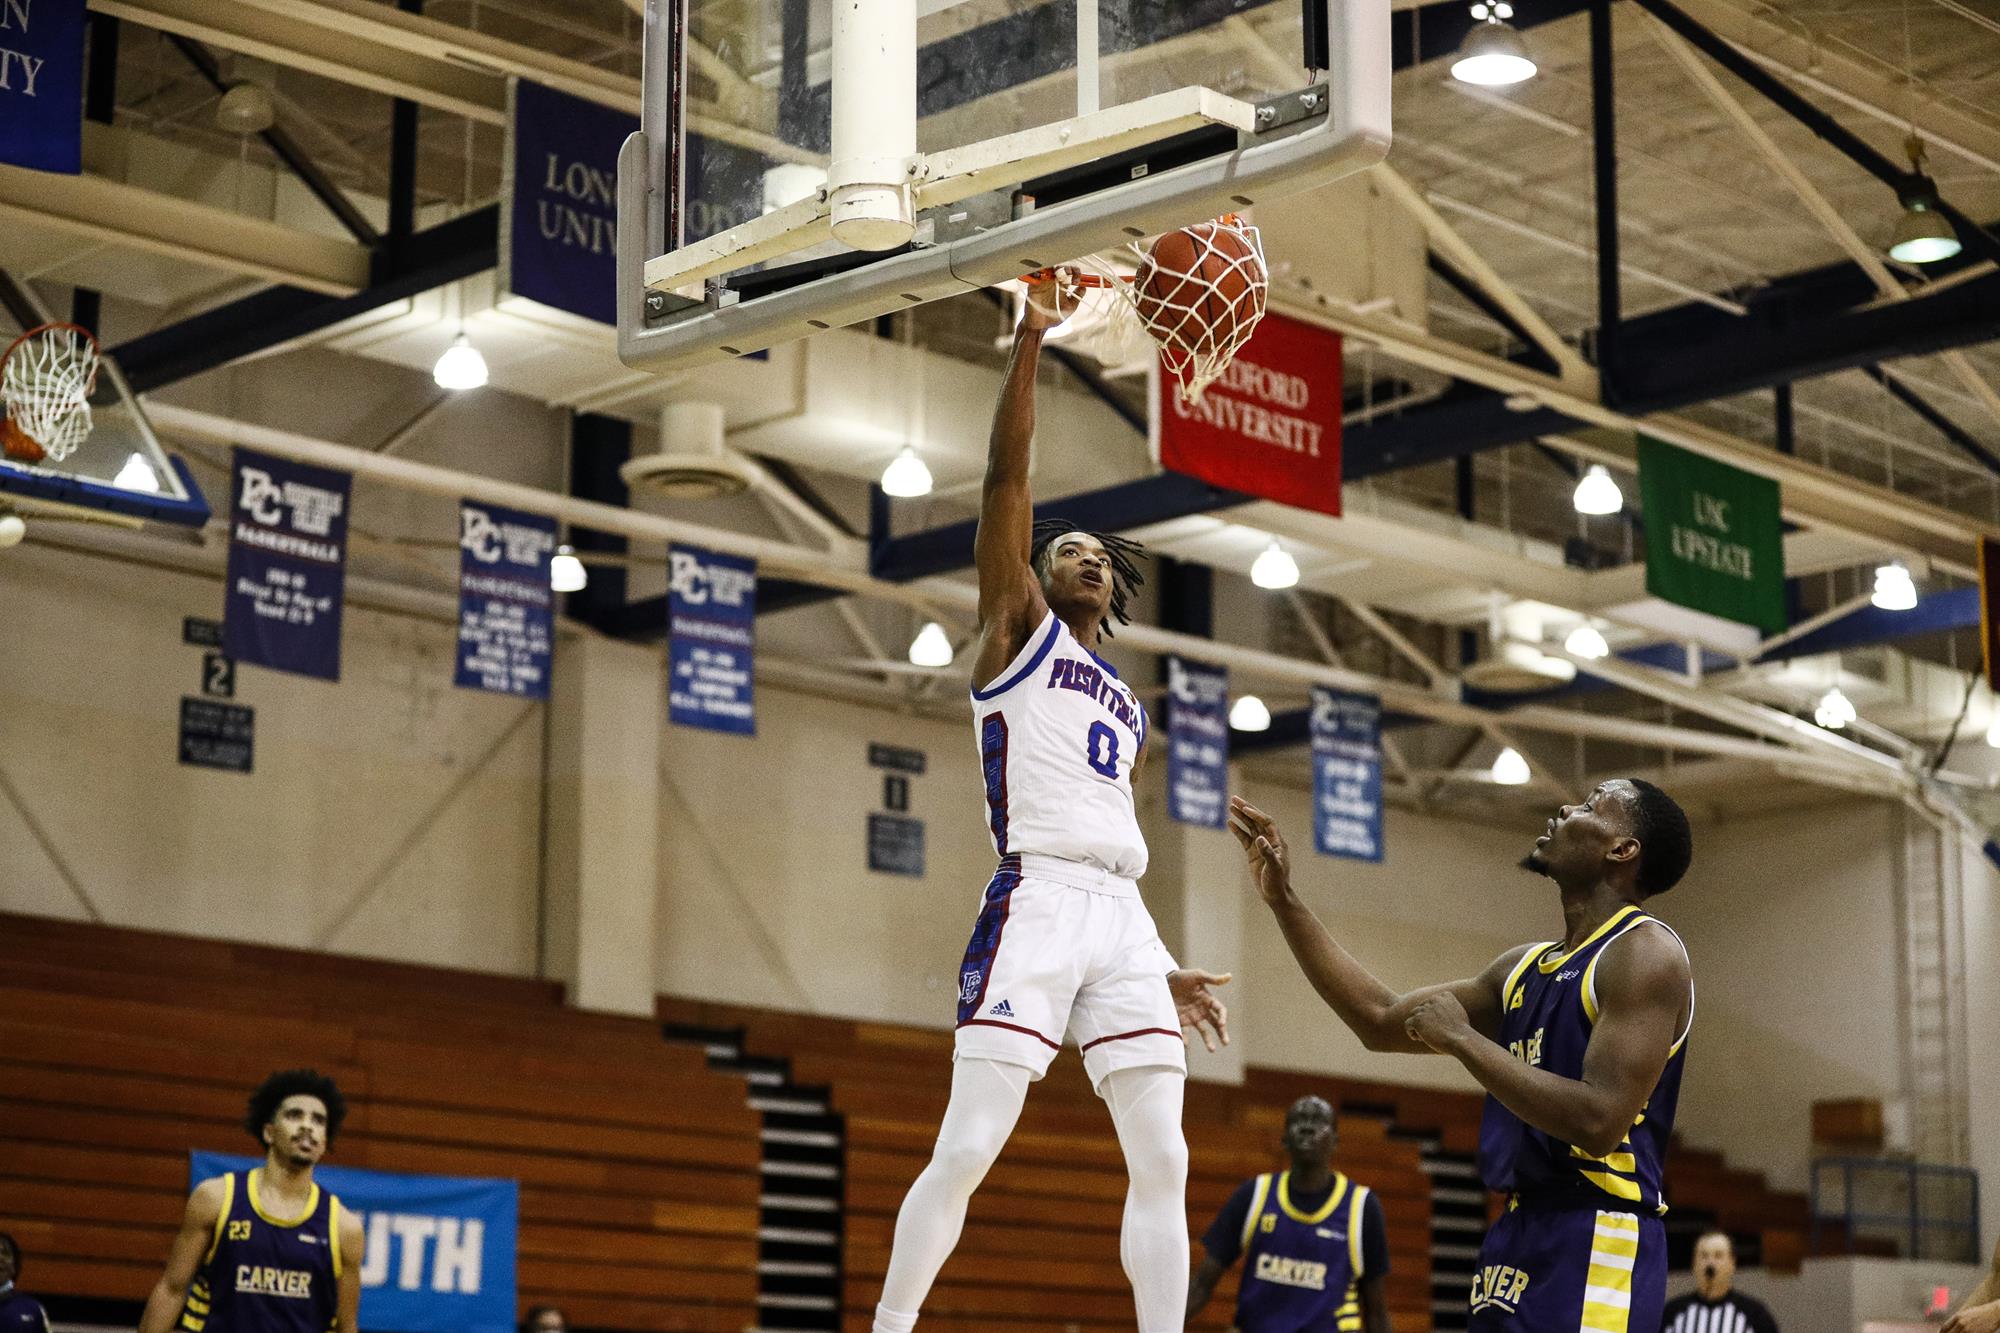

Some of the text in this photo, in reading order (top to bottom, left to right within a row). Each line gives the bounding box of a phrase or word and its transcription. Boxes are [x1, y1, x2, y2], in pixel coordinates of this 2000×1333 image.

[0, 48, 44, 97] TY
[1172, 382, 1322, 457] UNIVERSITY
[207, 656, 230, 693] 2
[1087, 719, 1120, 780] 0
[990, 1008, 1014, 1017] adidas
[228, 1219, 252, 1241] 23
[360, 1212, 483, 1294] UTH
[235, 1264, 312, 1299] CARVER
